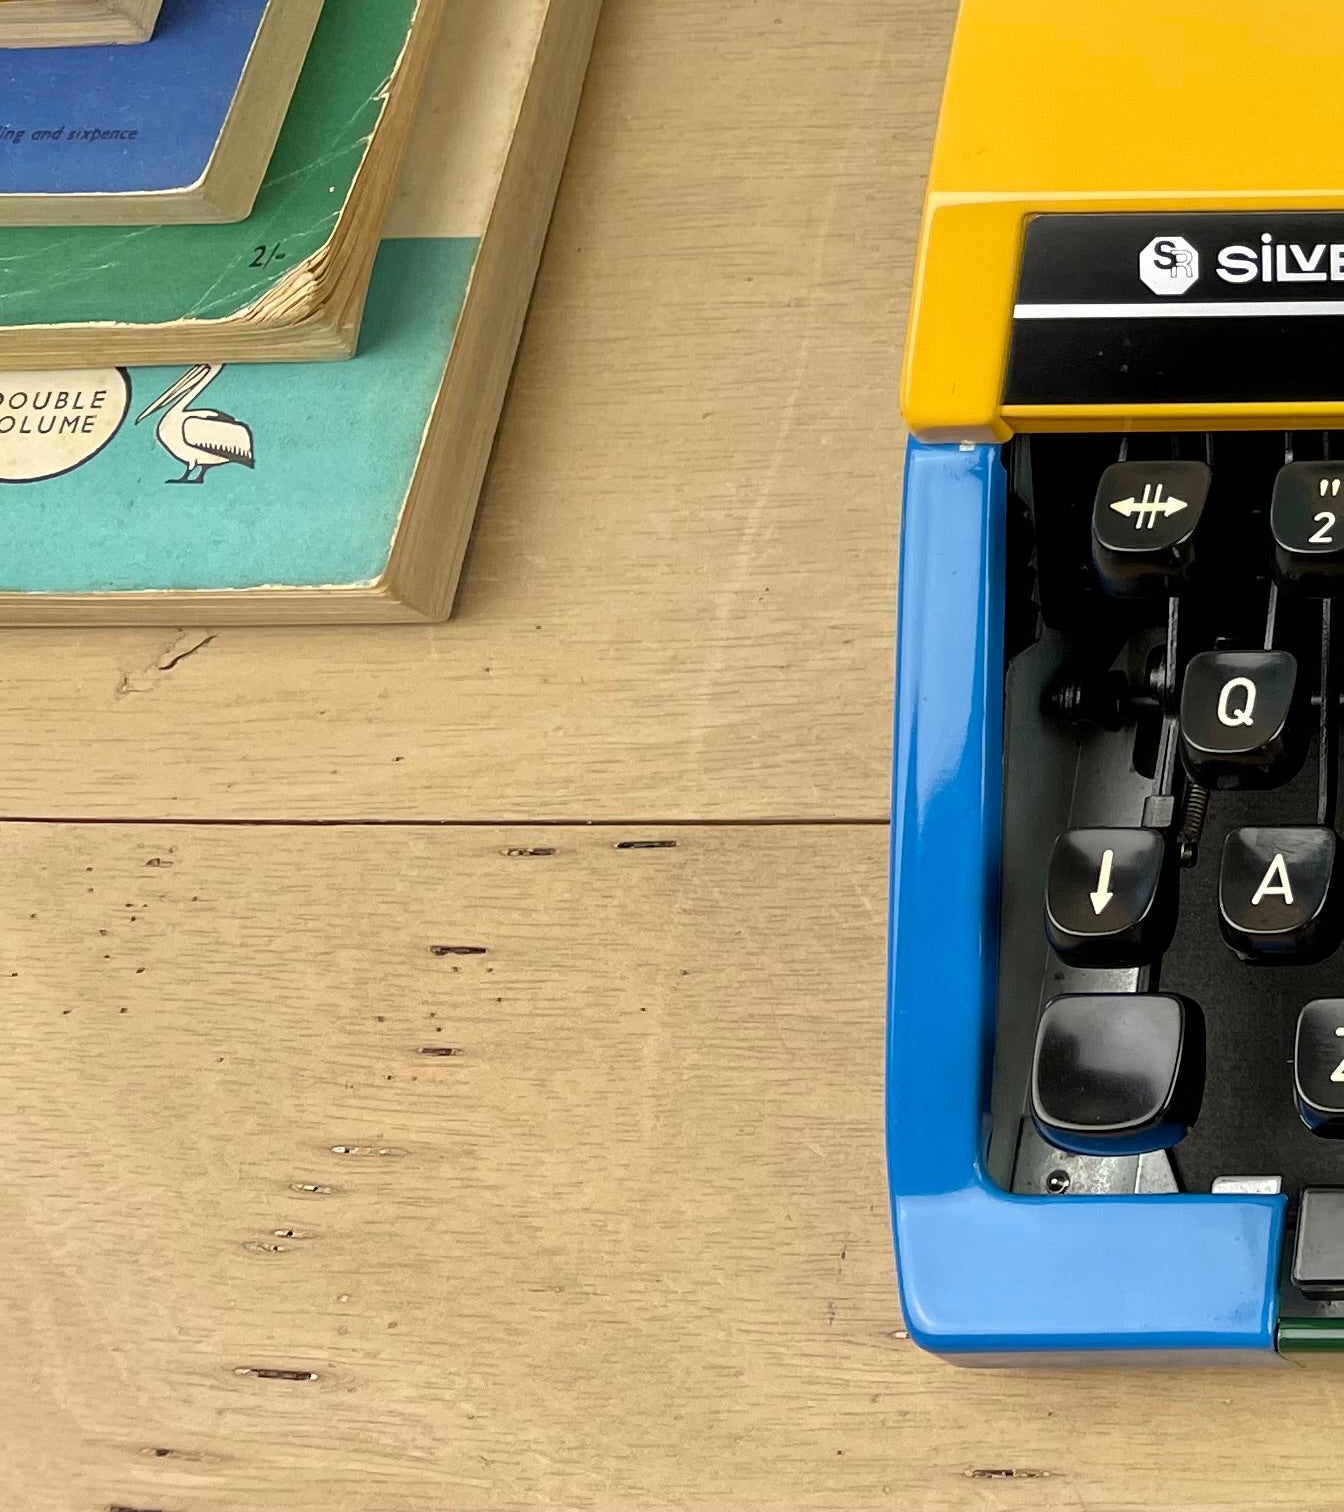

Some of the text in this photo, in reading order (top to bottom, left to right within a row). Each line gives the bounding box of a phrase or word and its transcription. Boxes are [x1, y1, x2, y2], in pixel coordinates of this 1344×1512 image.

[31, 126, 65, 141] and
[66, 128, 139, 143] sixpence
[248, 242, 286, 270] 2/-
[1308, 511, 1336, 543] 2
[1217, 677, 1257, 727] Q
[1251, 853, 1294, 905] A
